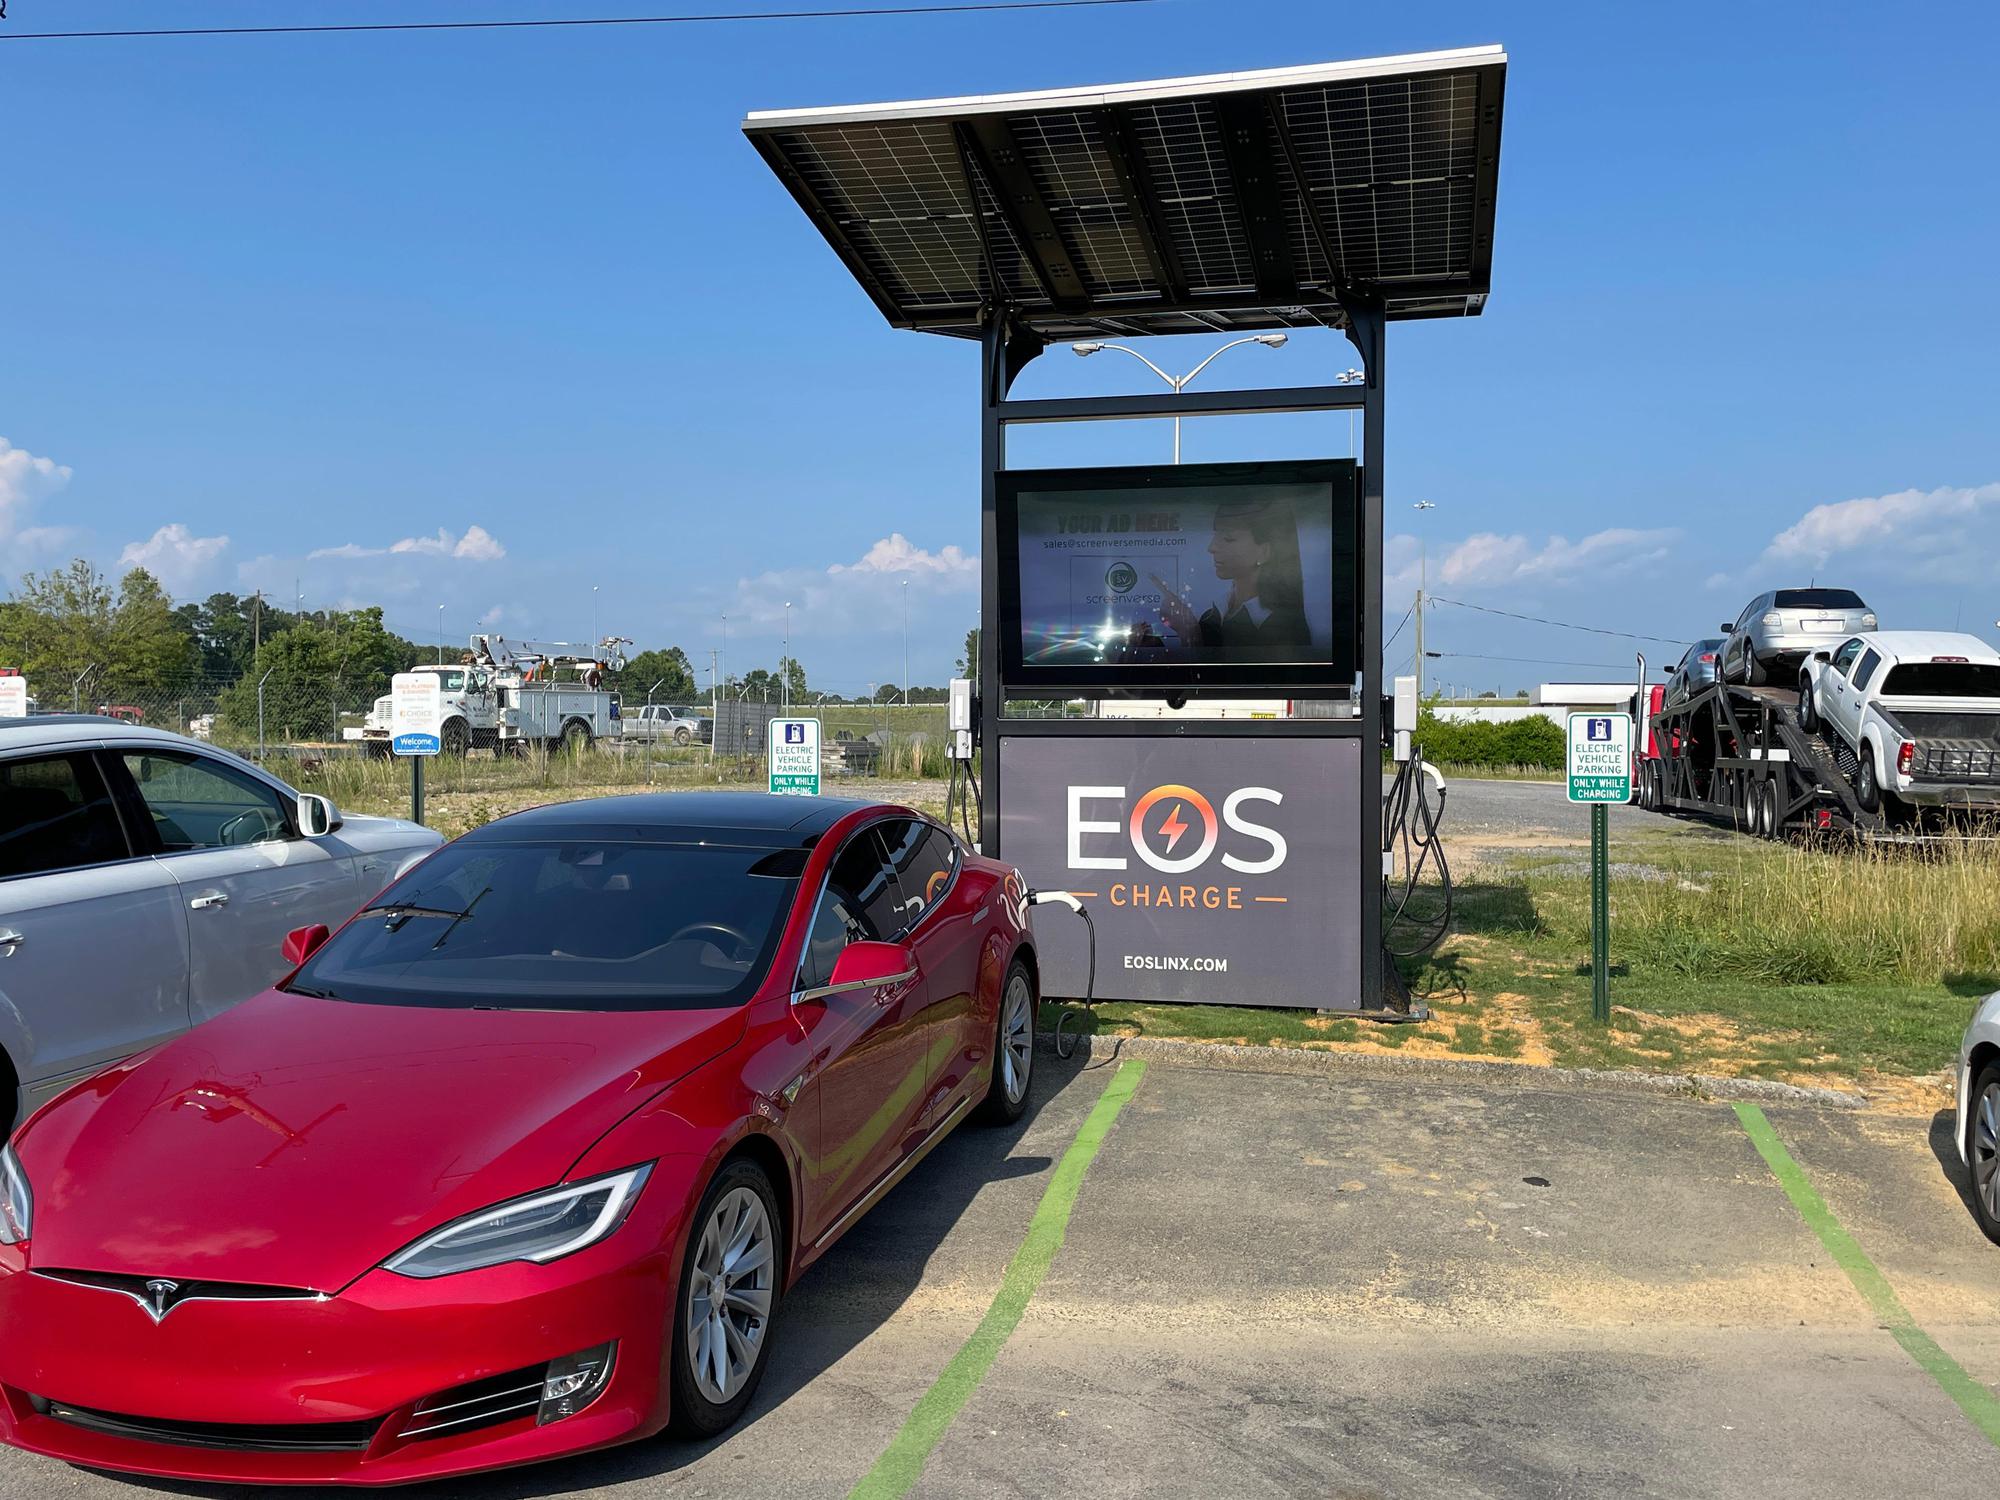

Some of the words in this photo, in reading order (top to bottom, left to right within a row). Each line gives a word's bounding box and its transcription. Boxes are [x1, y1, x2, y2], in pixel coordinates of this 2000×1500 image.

[1057, 513, 1104, 534] YOUR
[1106, 513, 1132, 533] AD
[1136, 512, 1181, 532] HERE
[1043, 536, 1187, 549] sales@screenversemedia.com
[1086, 593, 1161, 605] screenverse
[775, 746, 814, 755] ELECTRIC
[1575, 743, 1623, 753] ELECTRIC
[778, 755, 812, 764] VEHICLE
[1578, 754, 1621, 764] VEHICLE
[777, 765, 813, 773] PARKING
[1576, 765, 1622, 774] PARKING
[774, 777, 793, 786] ONLY
[794, 777, 816, 786] WHILE
[1573, 778, 1596, 788] ONLY
[1599, 778, 1625, 788] WHILE
[777, 786, 813, 795] CHARGING
[1577, 789, 1621, 799] CHARGING
[1067, 784, 1288, 874] EOS
[1109, 883, 1243, 909] CHARGE
[1123, 955, 1228, 973] EOSLINX.COM
